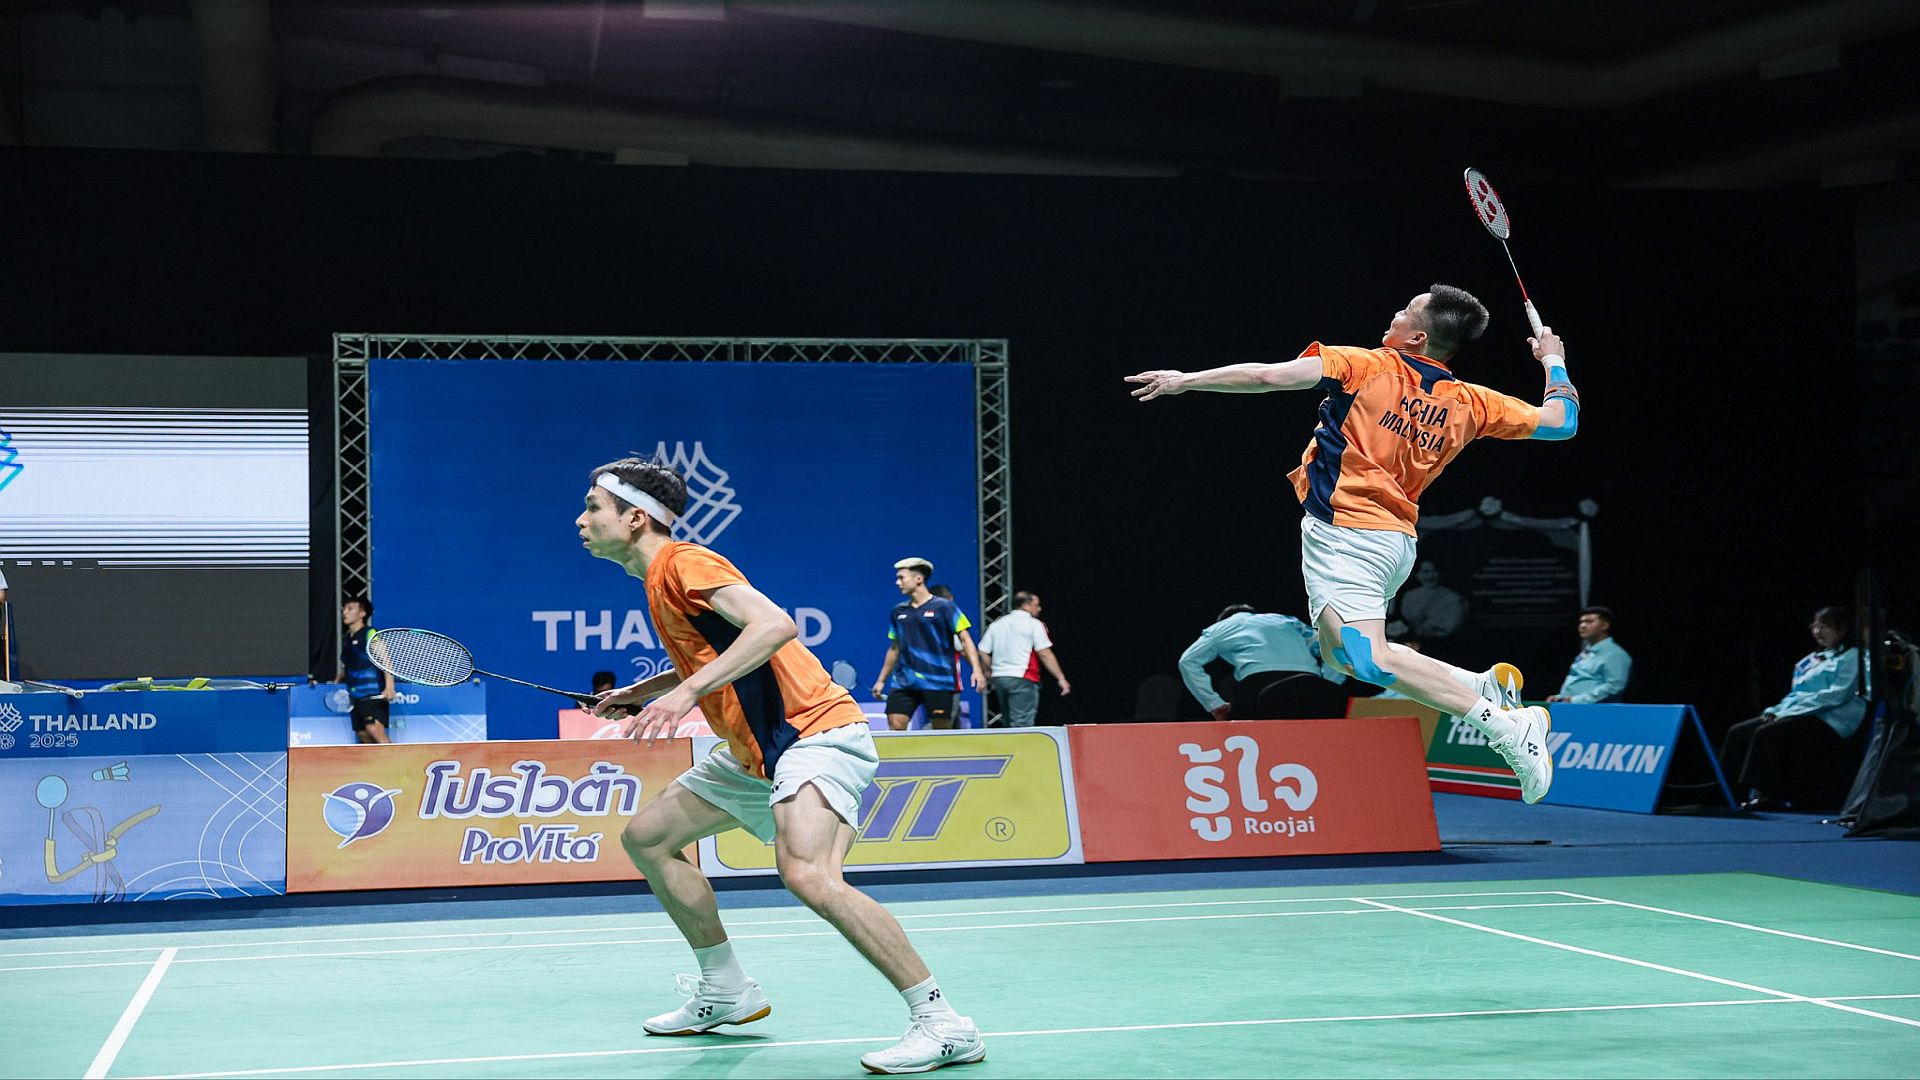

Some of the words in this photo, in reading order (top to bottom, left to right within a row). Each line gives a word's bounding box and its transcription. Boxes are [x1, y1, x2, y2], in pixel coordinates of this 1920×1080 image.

[29, 713, 157, 732] THAILAND
[29, 733, 79, 748] 2025
[1558, 742, 1664, 774] DAIKIN
[420, 762, 640, 817] โปรไวต้า
[1178, 735, 1319, 841] รู้ใจ
[1244, 815, 1316, 838] Roojai
